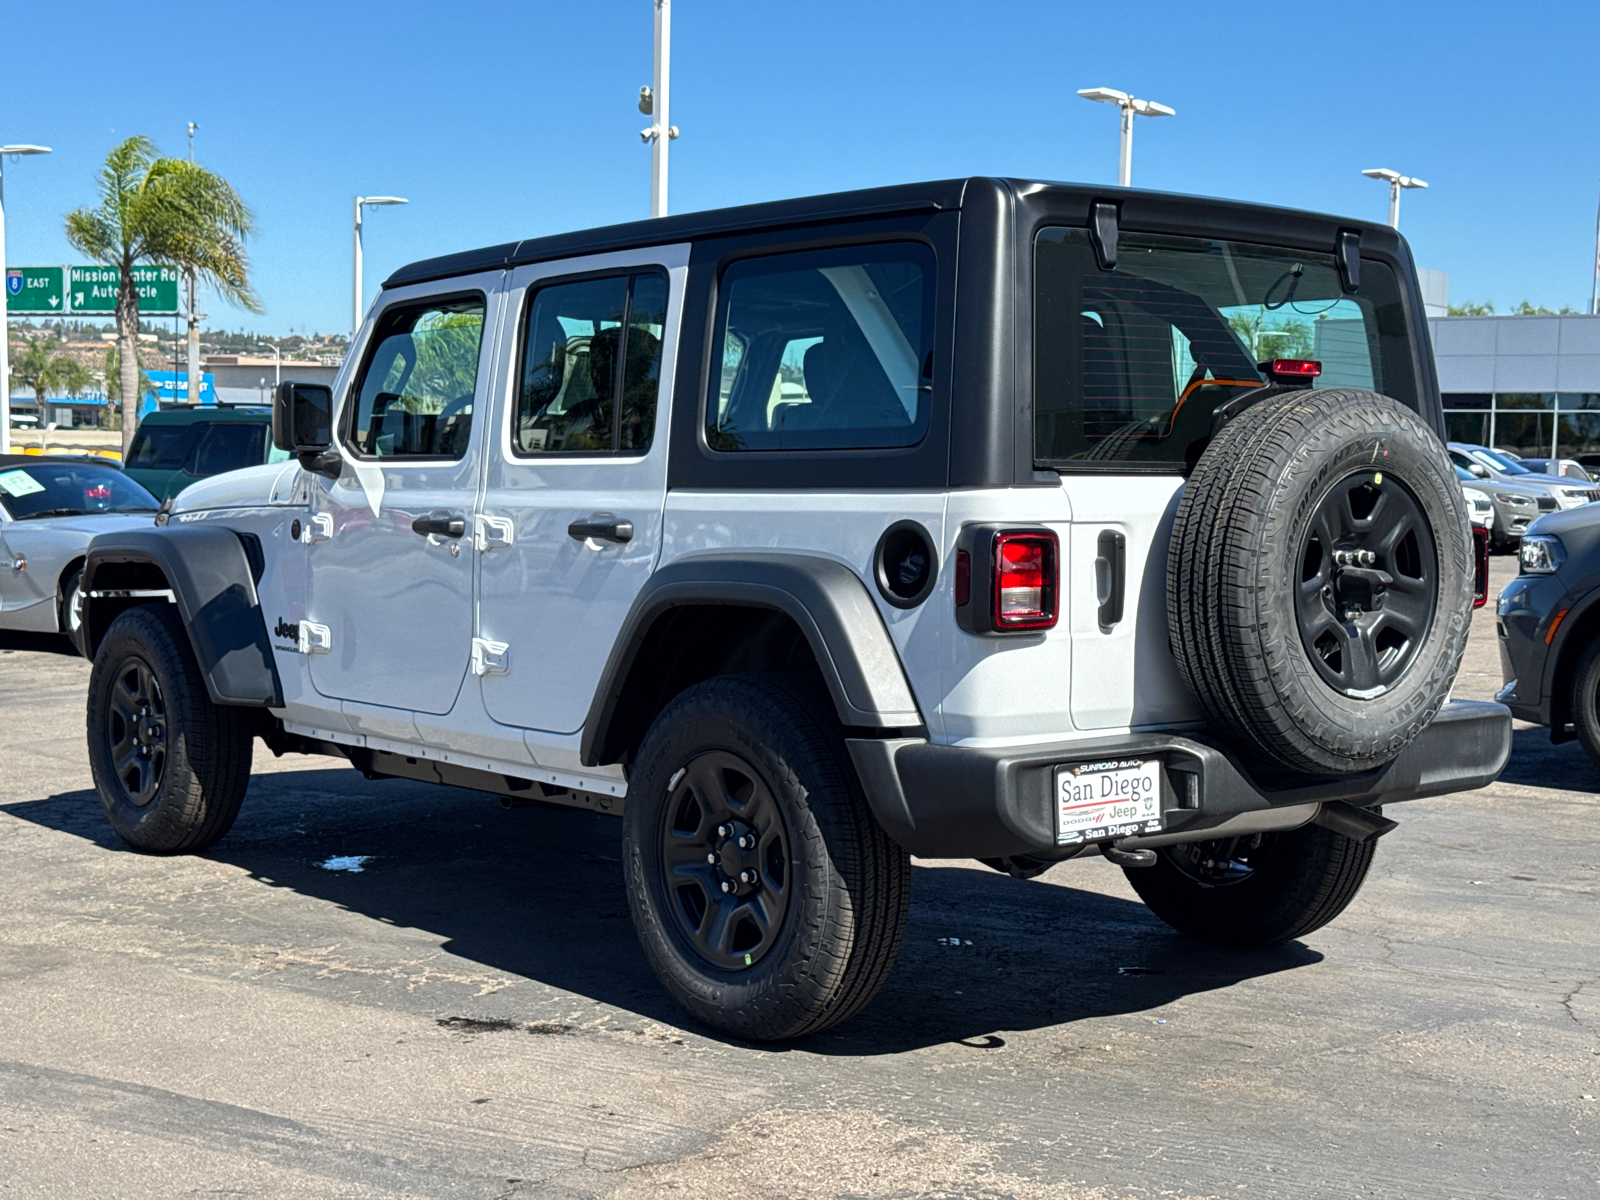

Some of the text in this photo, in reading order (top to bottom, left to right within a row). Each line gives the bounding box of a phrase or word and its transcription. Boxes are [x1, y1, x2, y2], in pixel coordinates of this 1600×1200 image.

[27, 277, 50, 289] EAST
[72, 268, 116, 283] Mission
[12, 278, 18, 289] 8
[1394, 628, 1460, 725] NEXEN
[1079, 758, 1140, 773] SUNROAD AUTO
[1062, 773, 1152, 803] San Diego
[1109, 805, 1137, 819] Jeep
[1085, 828, 1106, 839] San
[1108, 823, 1139, 836] Diego
